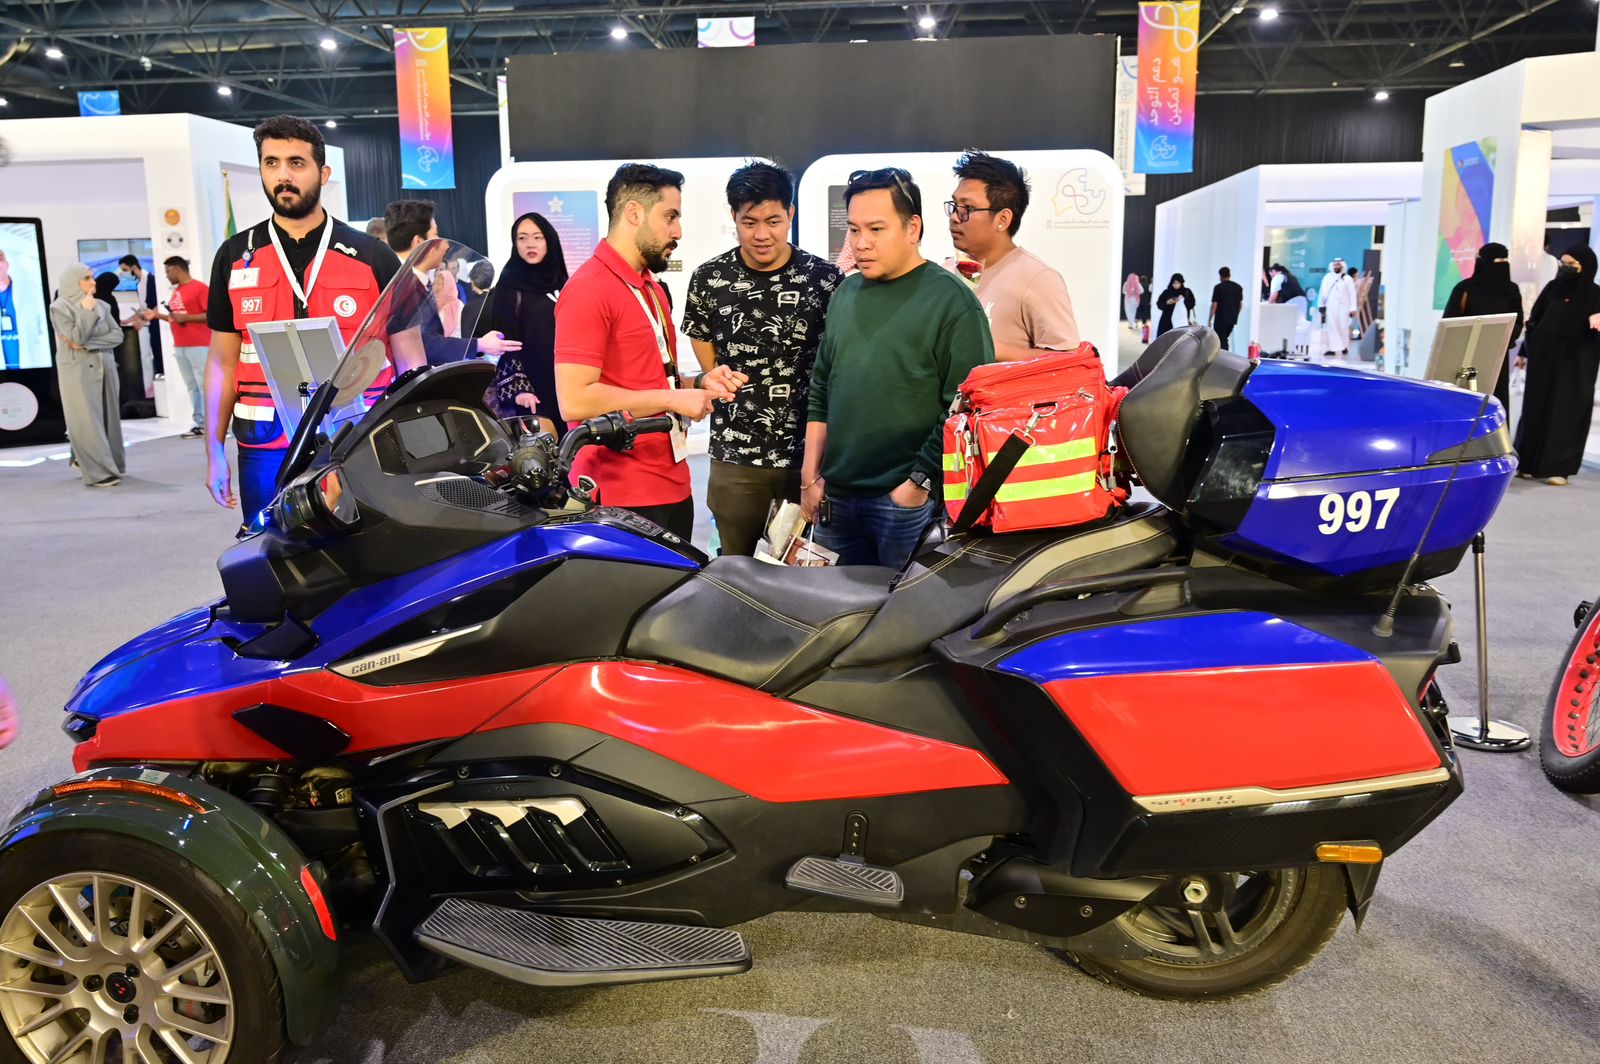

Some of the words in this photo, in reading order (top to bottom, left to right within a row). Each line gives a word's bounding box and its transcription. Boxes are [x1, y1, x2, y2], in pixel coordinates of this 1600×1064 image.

[1152, 57, 1166, 83] دعم
[1147, 87, 1162, 126] التوحد
[1167, 87, 1182, 126] تمكين
[242, 299, 261, 312] 997
[1318, 487, 1400, 535] 997
[351, 653, 400, 674] can-am
